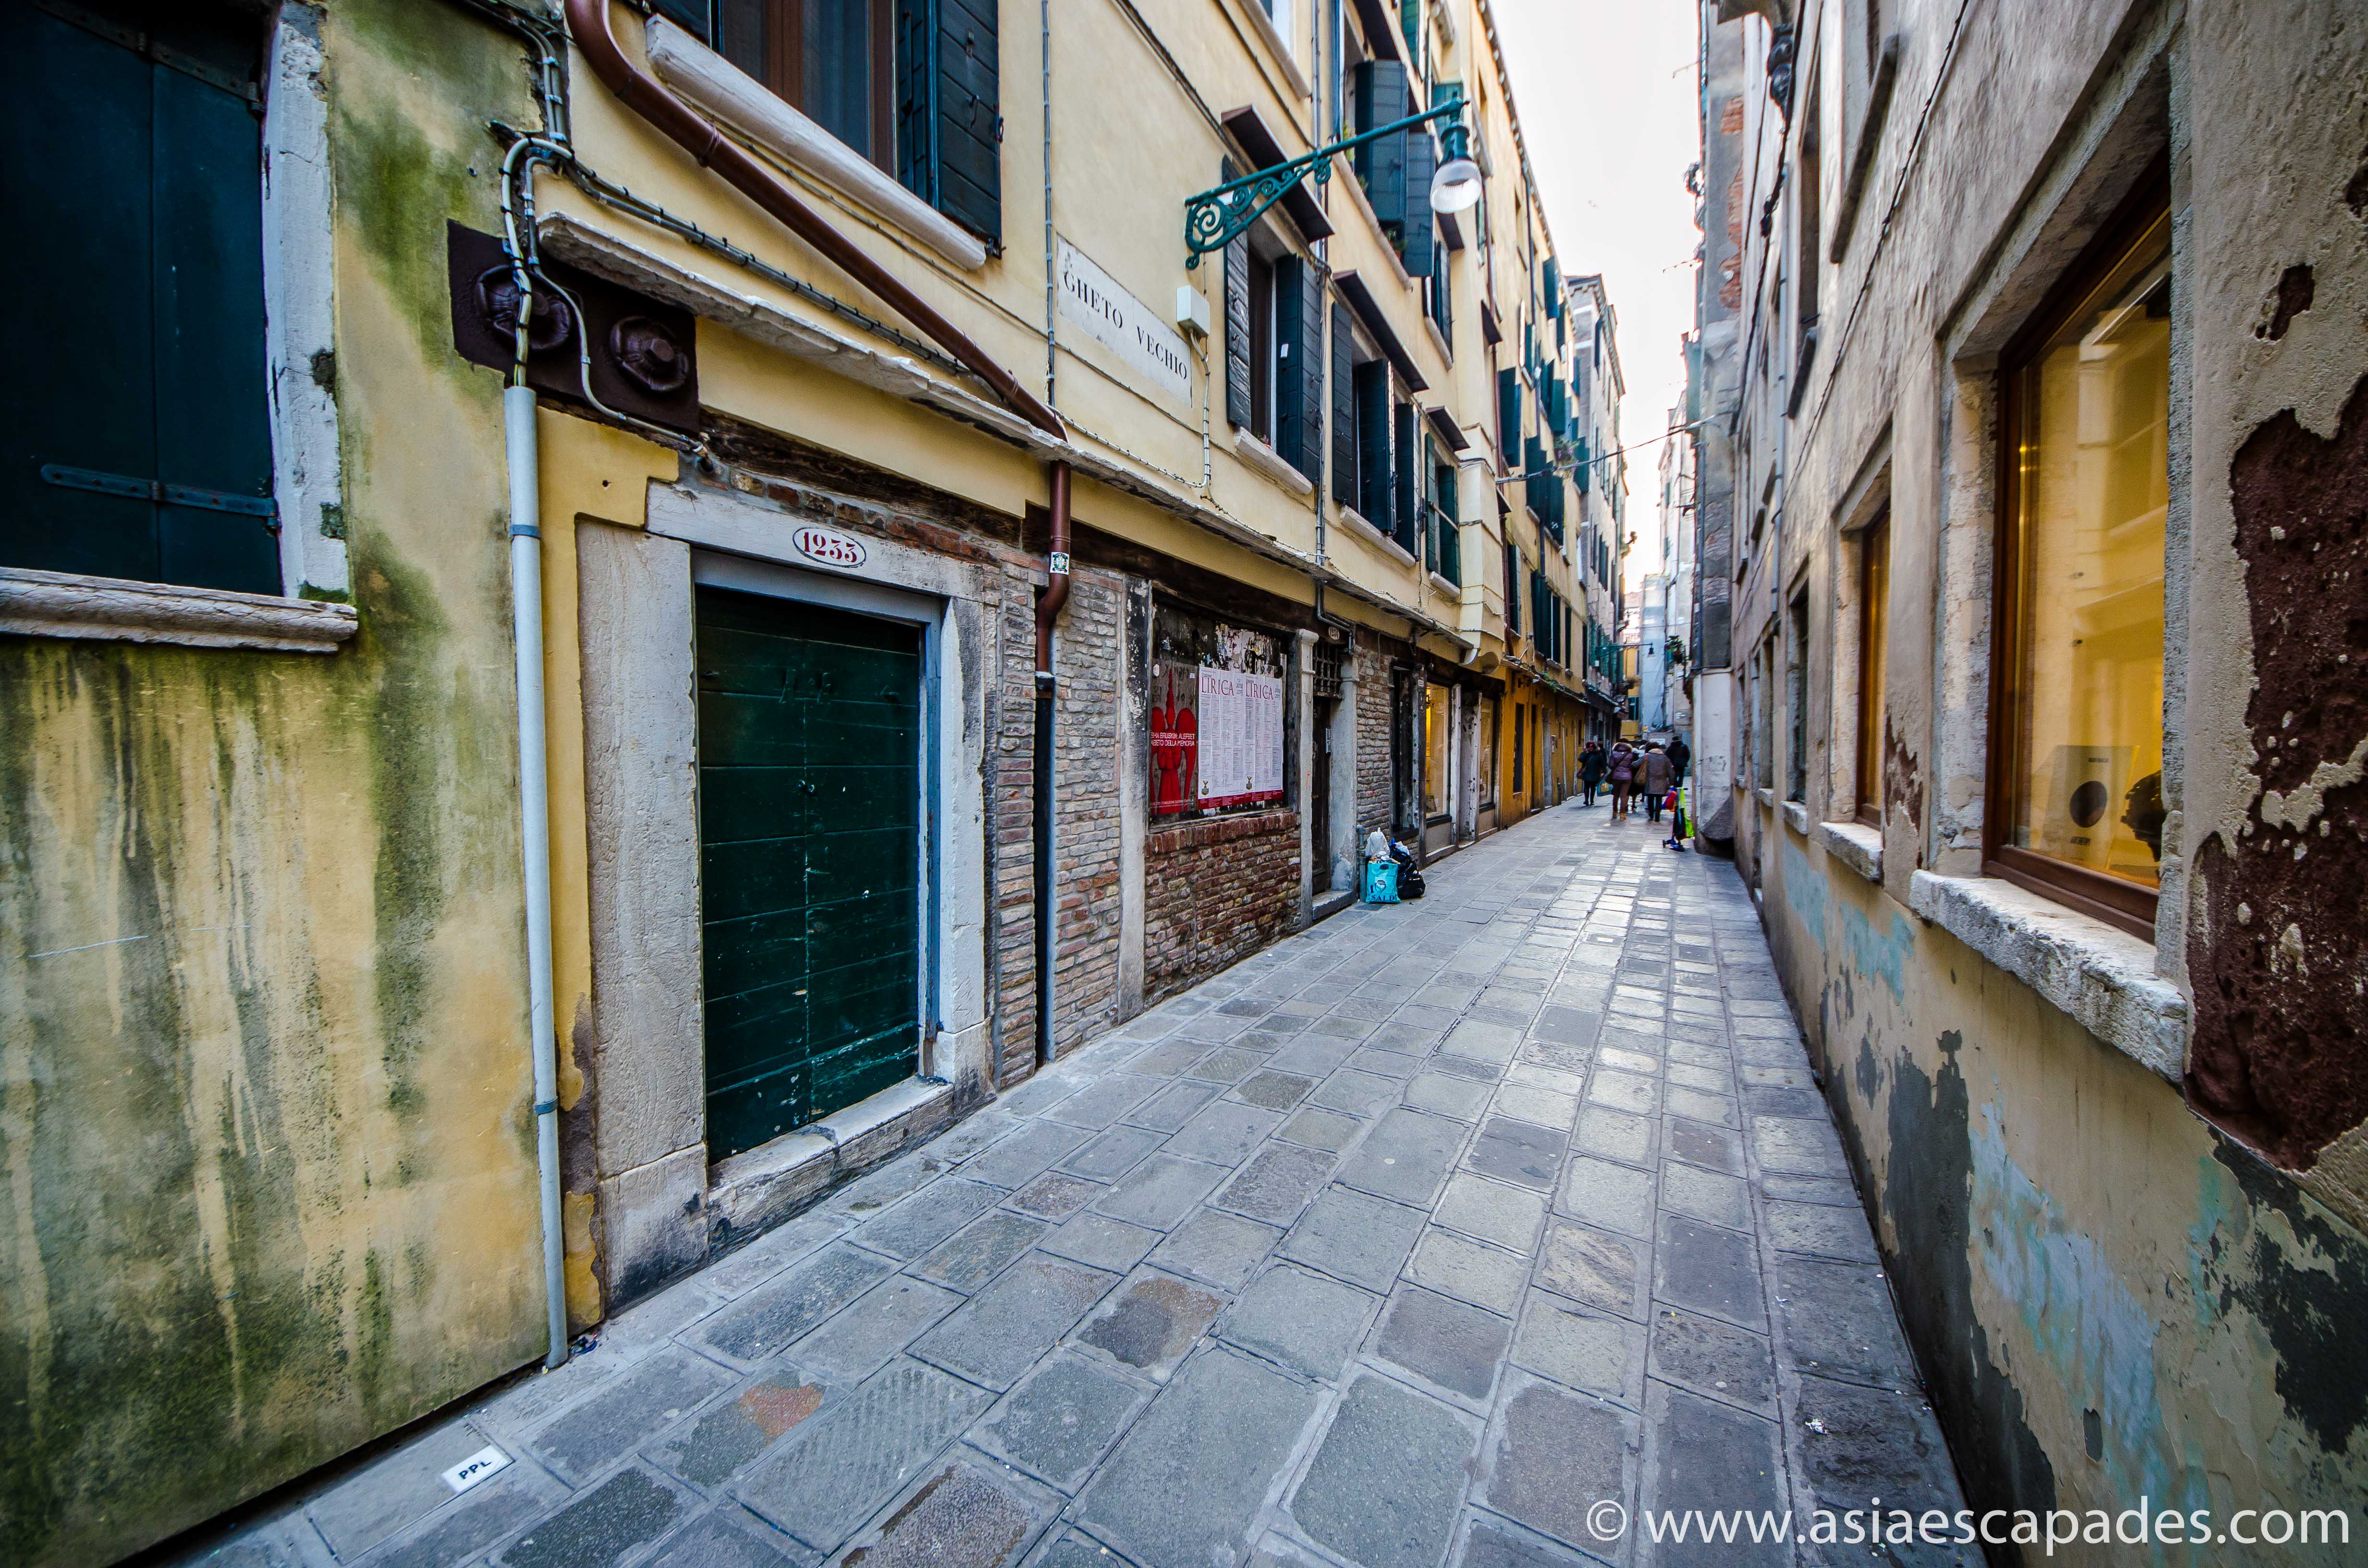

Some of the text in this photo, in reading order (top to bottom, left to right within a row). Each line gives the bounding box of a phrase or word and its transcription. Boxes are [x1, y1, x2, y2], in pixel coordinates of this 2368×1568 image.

[1064, 270, 1187, 380] GHETO VECHIO
[803, 531, 857, 563] 1233
[1201, 677, 1234, 696] LIRICA
[1246, 682, 1273, 700] LIRICA
[458, 1461, 493, 1480] PPL
